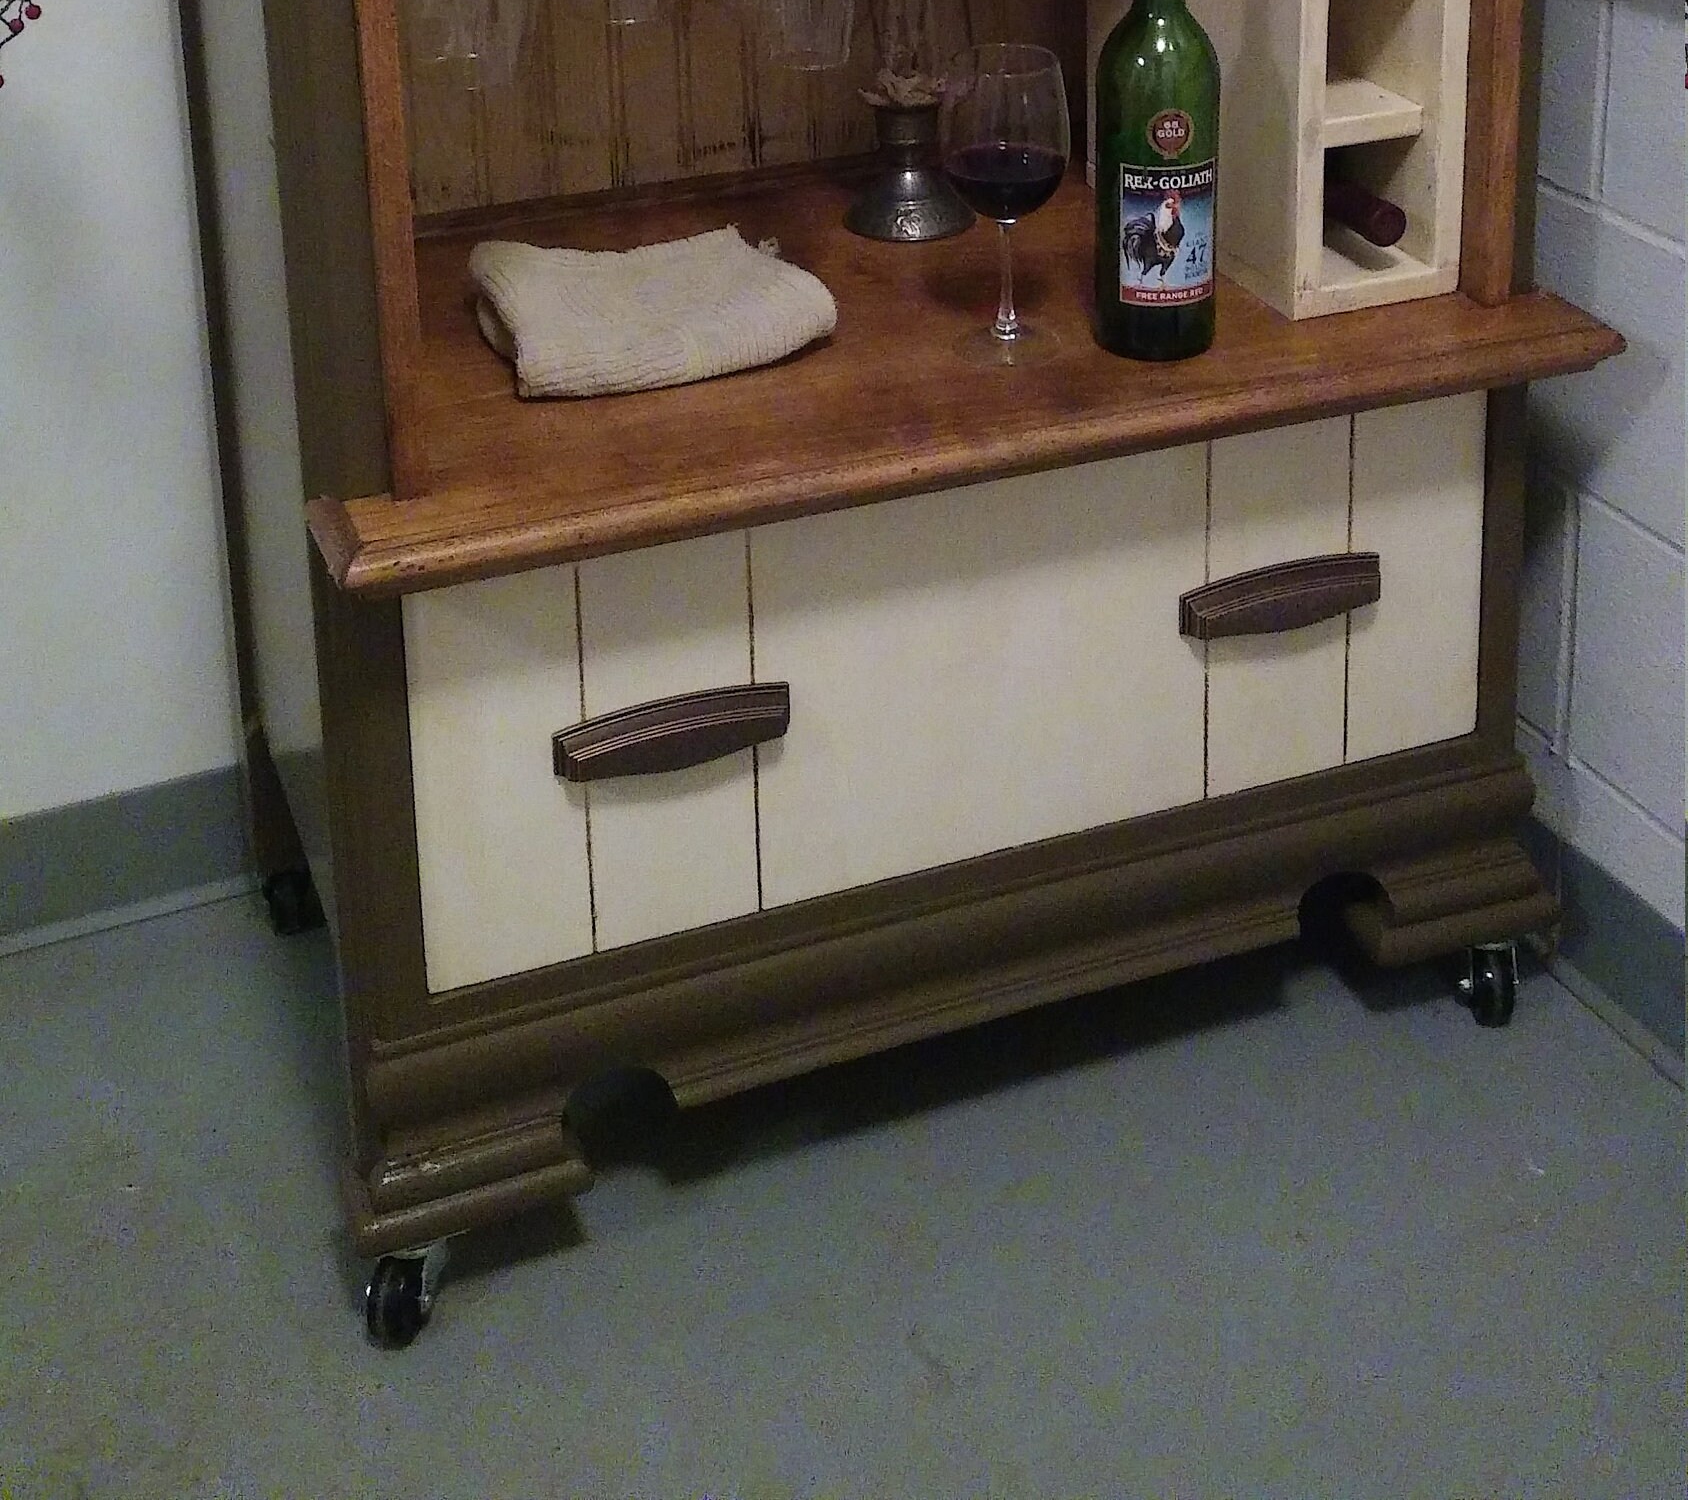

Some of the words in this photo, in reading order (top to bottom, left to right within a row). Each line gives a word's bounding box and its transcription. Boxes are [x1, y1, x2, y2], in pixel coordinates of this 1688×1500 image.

[1157, 128, 1185, 138] GOLD
[1124, 168, 1213, 190] REX-GOLIATH
[1186, 243, 1207, 264] 47
[1135, 291, 1158, 301] FREE
[1159, 290, 1188, 301] RANGE
